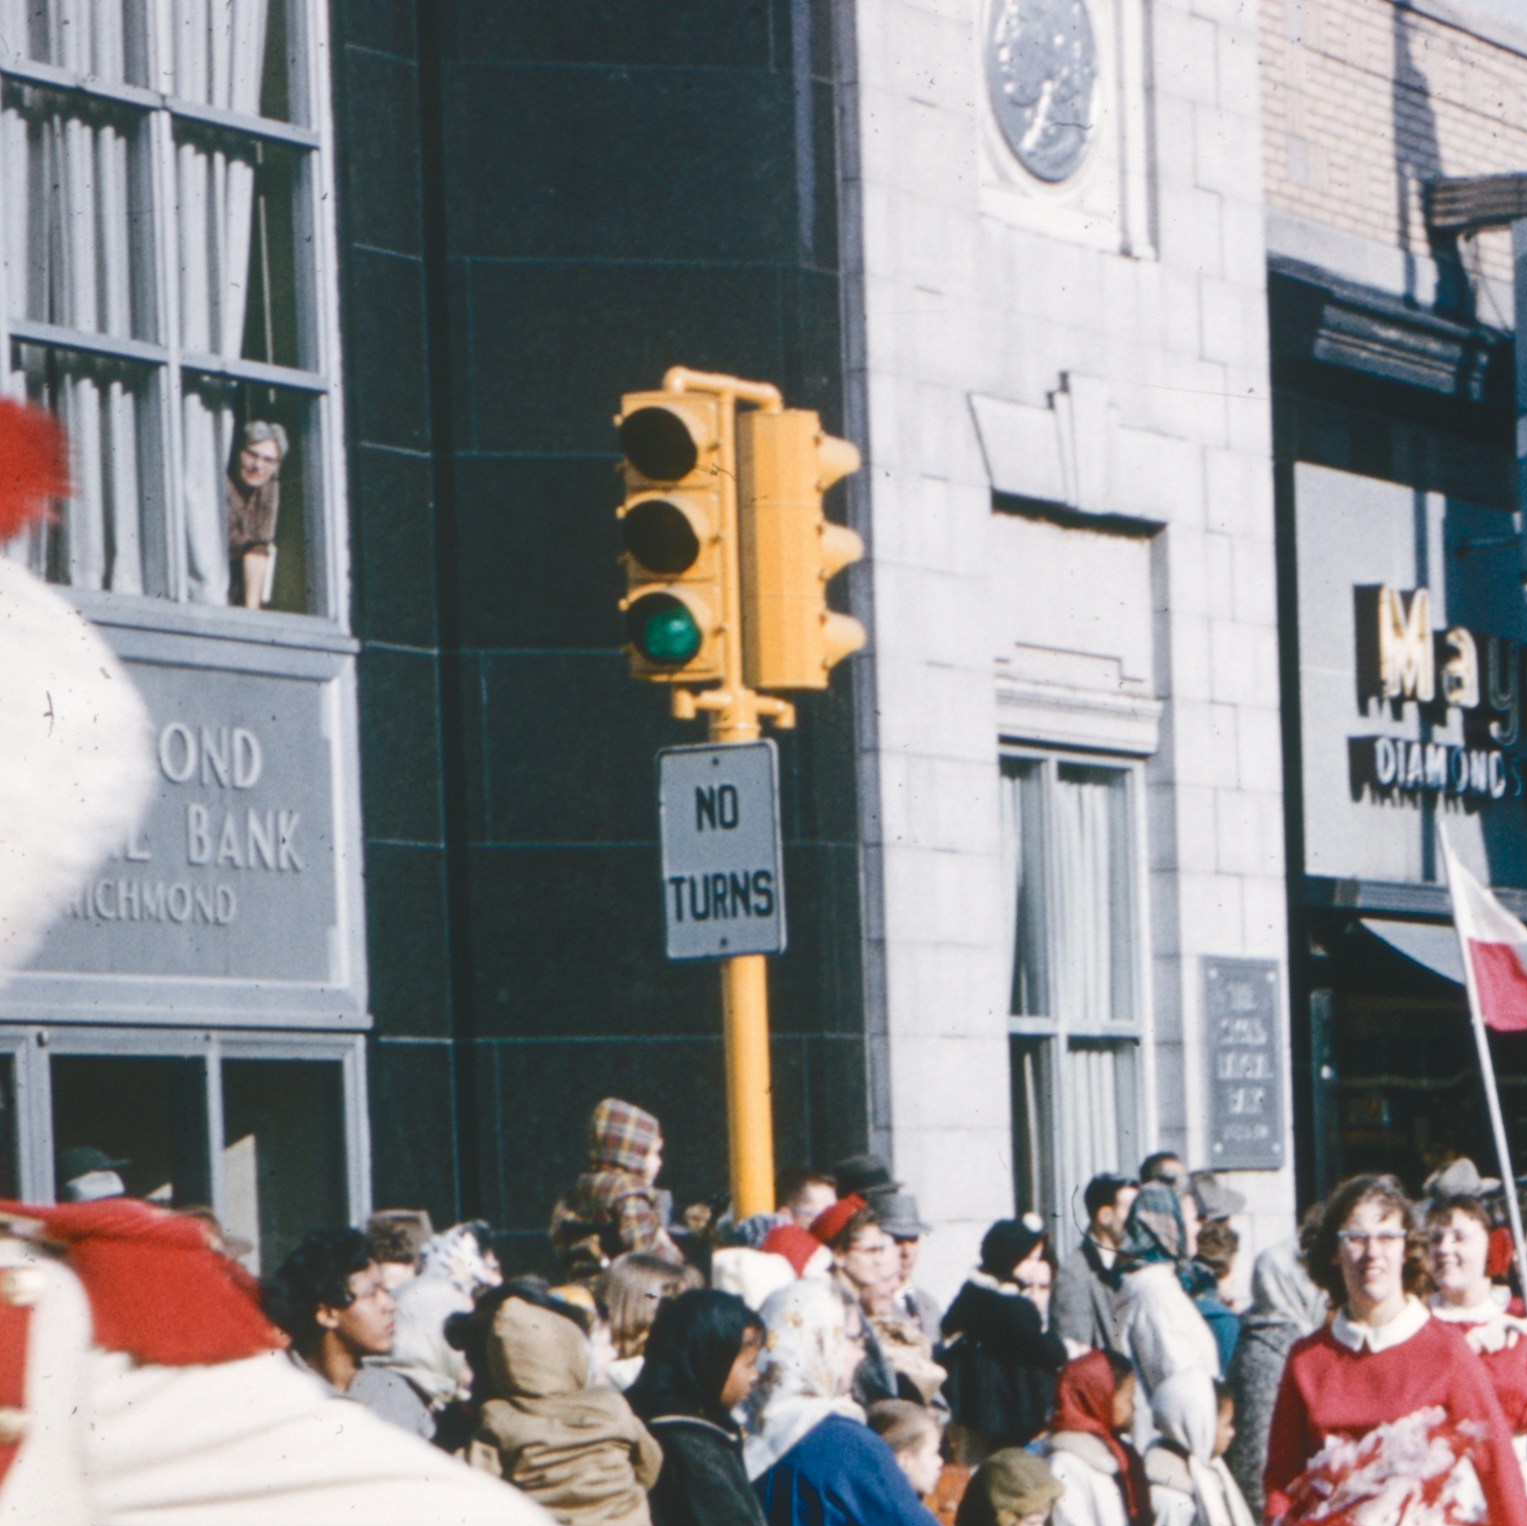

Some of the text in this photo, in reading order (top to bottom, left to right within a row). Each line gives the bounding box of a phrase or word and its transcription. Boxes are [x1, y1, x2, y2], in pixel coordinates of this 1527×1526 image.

[1374, 735, 1525, 799] DIAMONDS
[186, 801, 304, 873] BANK
[695, 784, 739, 832] NO
[669, 870, 774, 922] TURNS
